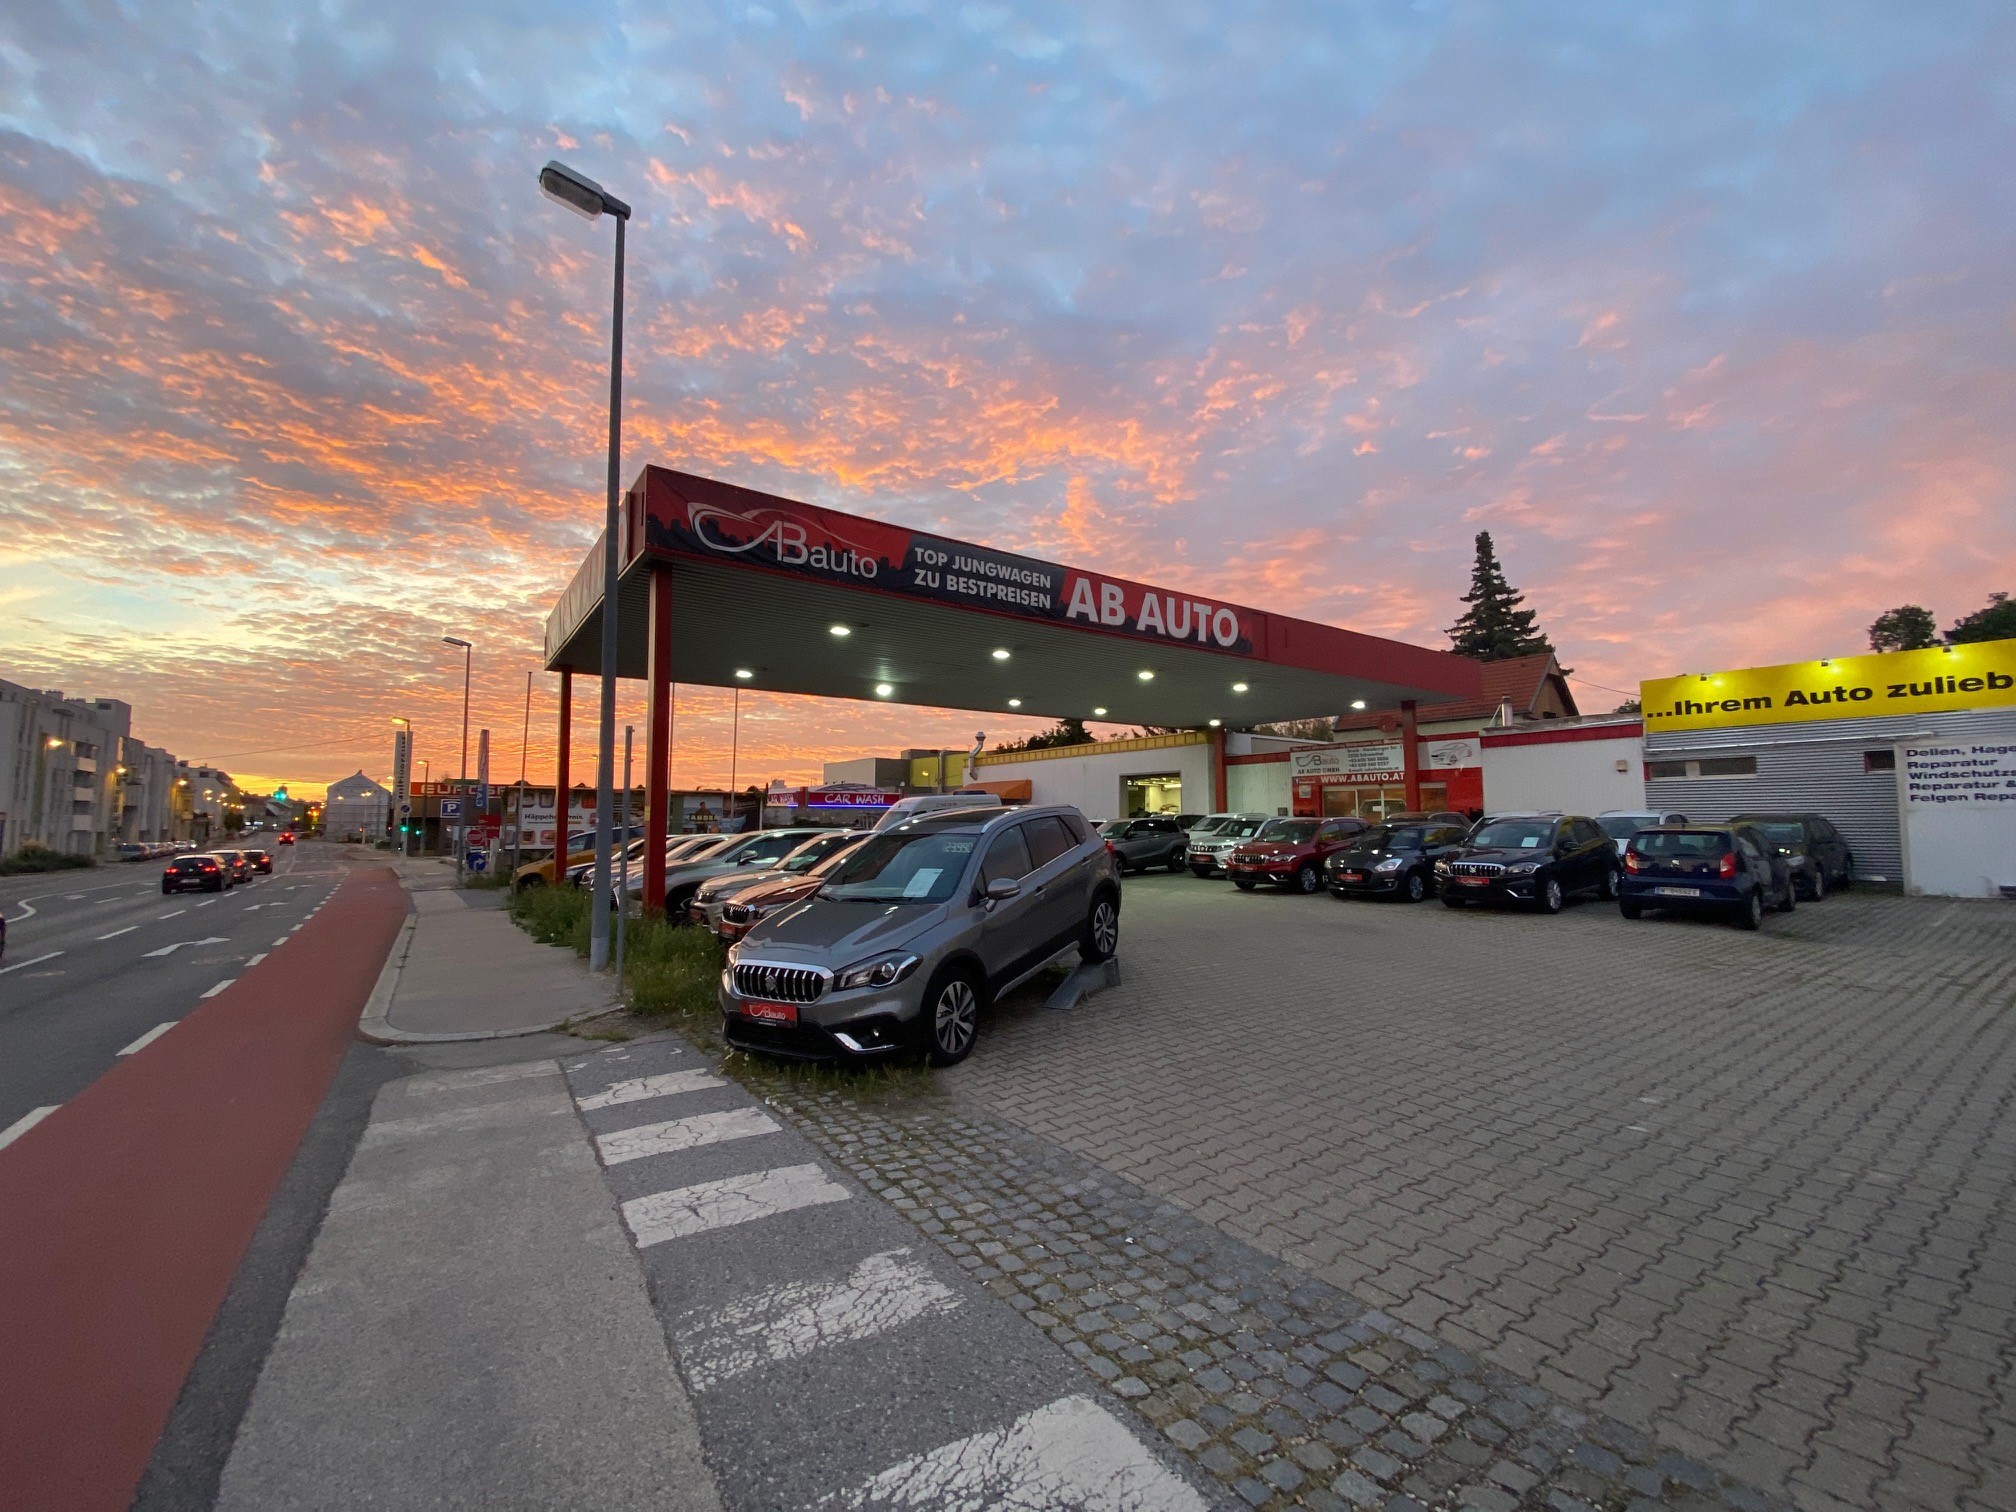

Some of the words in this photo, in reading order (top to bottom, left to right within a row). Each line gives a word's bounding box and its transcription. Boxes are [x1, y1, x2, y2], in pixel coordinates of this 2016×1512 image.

[914, 547, 948, 567] TOP
[951, 555, 1051, 589] JUNGWAGEN
[914, 569, 940, 588] ZU
[946, 574, 1051, 609] BESTPREISEN
[1066, 577, 1126, 626] AB
[1136, 592, 1239, 647] AUTO
[1784, 686, 1873, 706] Auto
[1887, 671, 2014, 698] zulieb
[1907, 759, 1998, 769] Reparatur
[1320, 772, 1404, 783] WWW.ABAUTO.AT
[1909, 781, 2000, 791] Reparatur
[824, 794, 851, 804] CAR
[856, 794, 884, 804] WASH
[1910, 794, 1969, 803] Felgen
